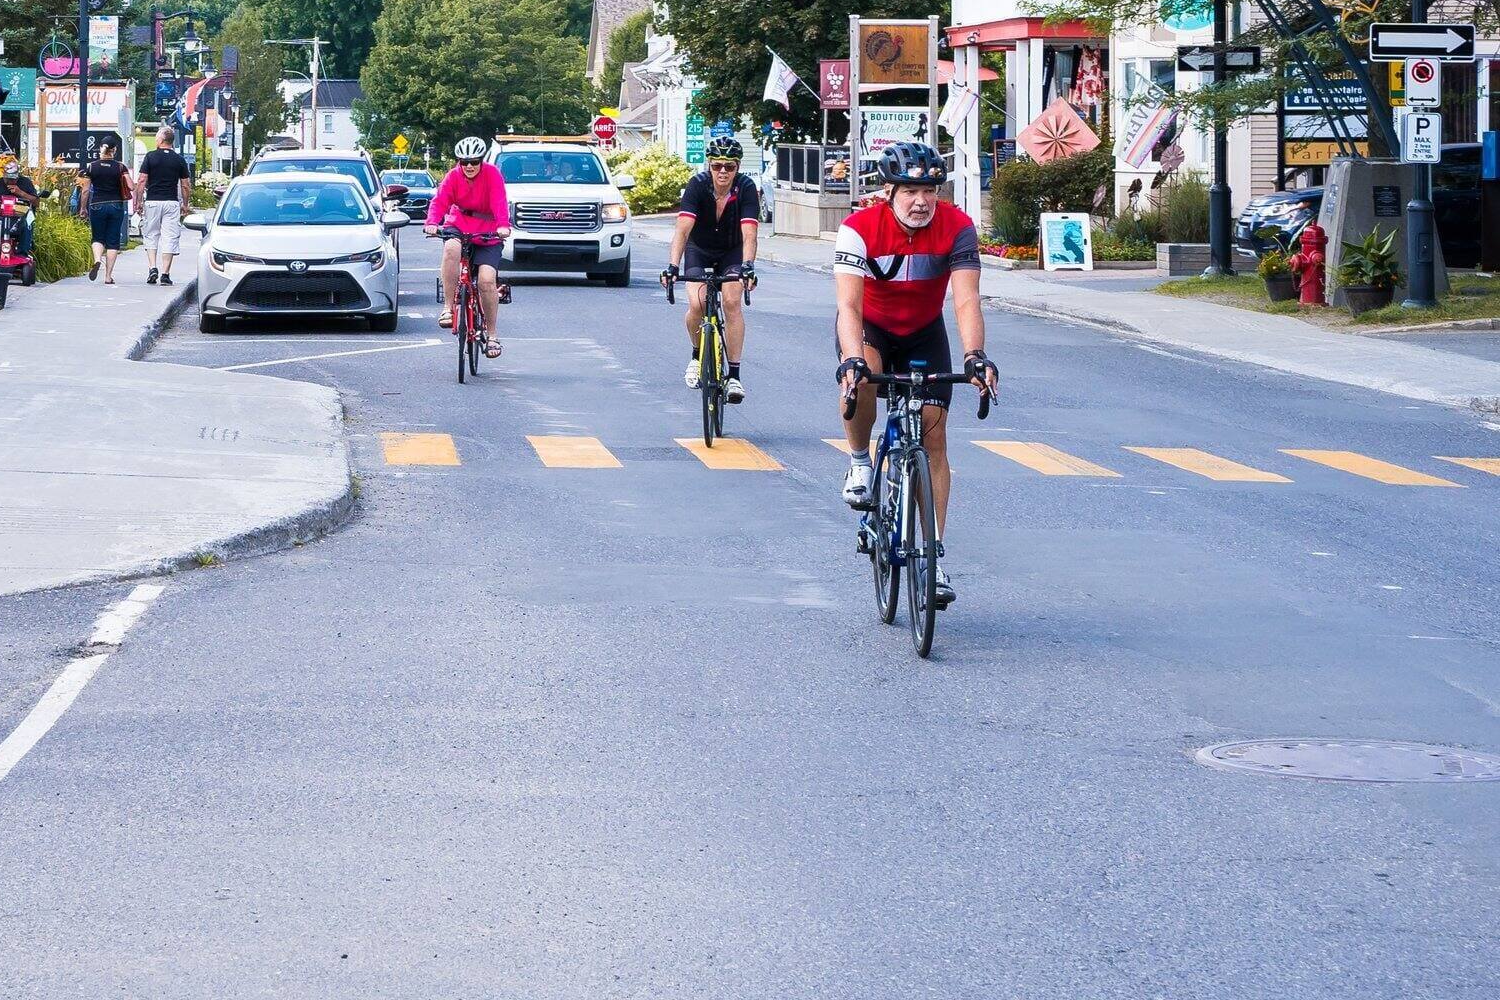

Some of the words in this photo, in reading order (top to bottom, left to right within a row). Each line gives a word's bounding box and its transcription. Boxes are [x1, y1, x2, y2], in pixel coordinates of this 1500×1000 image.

[37, 91, 106, 105] OKKKU
[870, 113, 916, 121] BOUTIQUE
[594, 123, 616, 132] ARRÊT
[688, 123, 702, 133] 215
[1416, 117, 1431, 135] P
[540, 211, 573, 220] GMC
